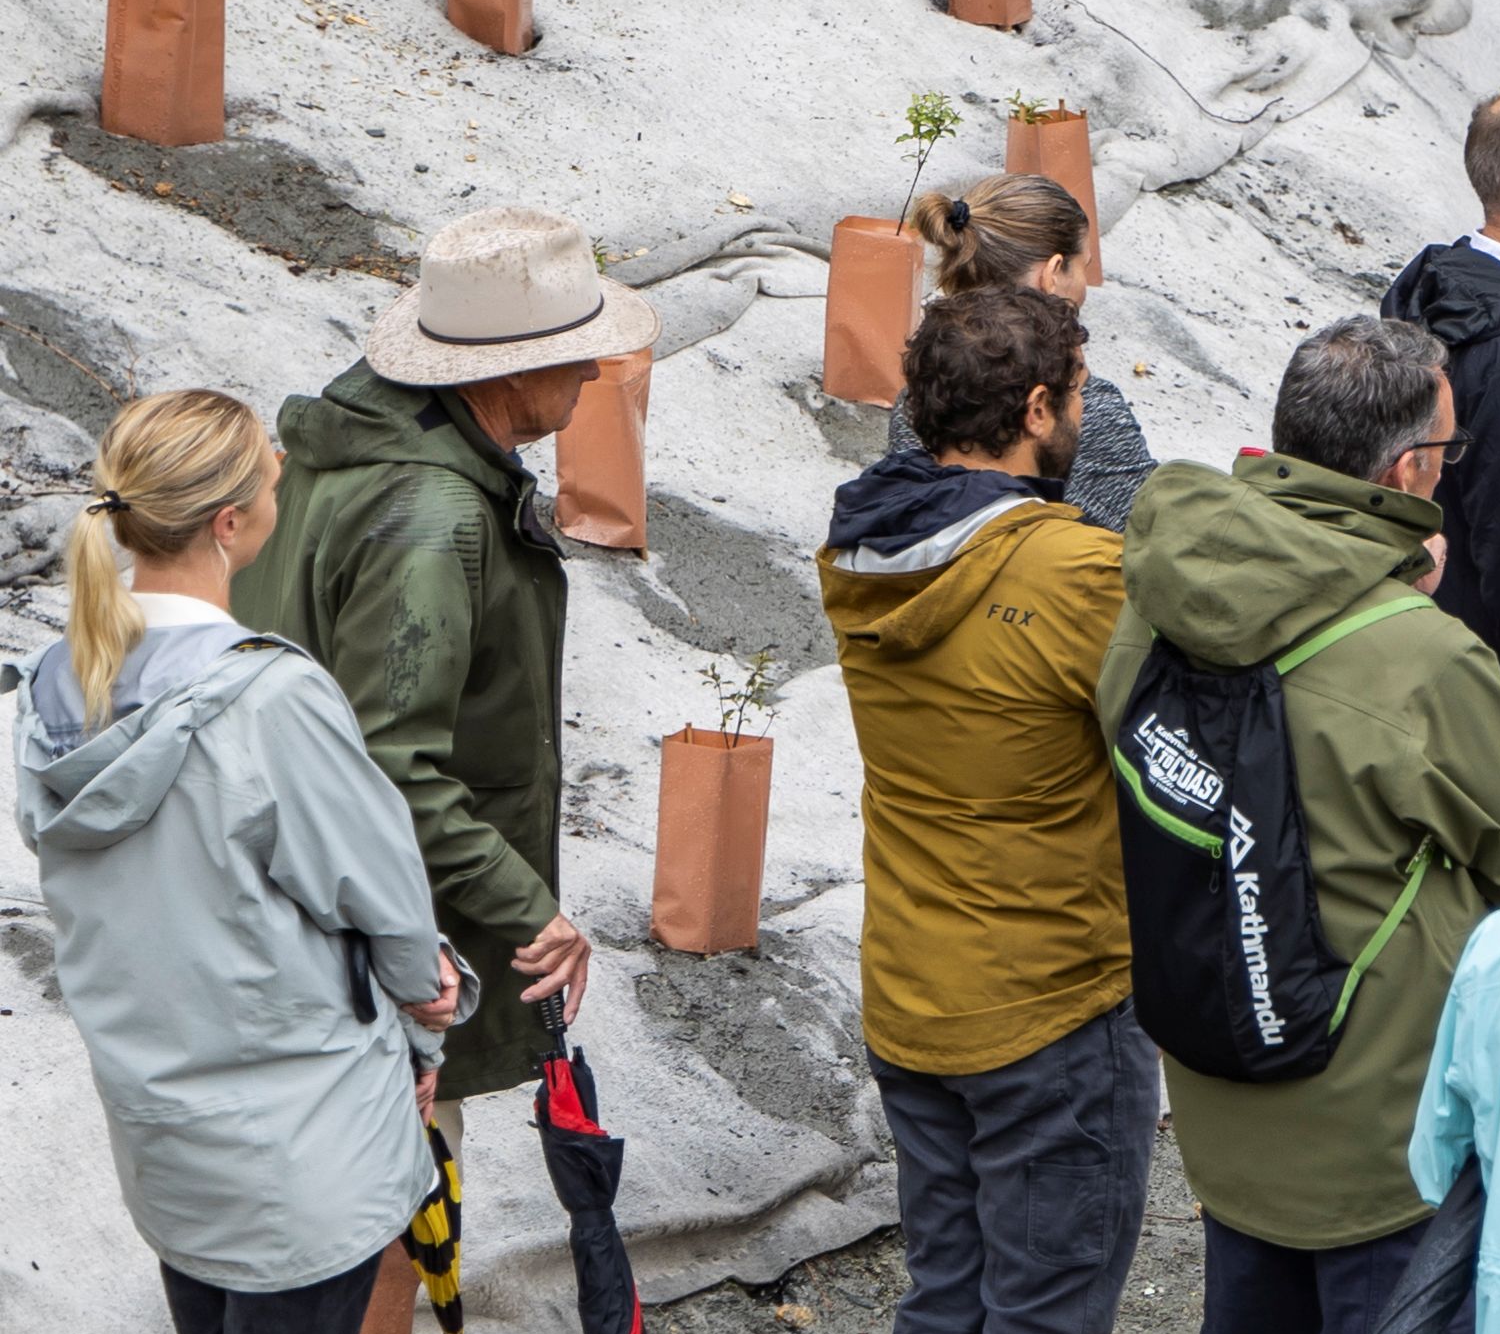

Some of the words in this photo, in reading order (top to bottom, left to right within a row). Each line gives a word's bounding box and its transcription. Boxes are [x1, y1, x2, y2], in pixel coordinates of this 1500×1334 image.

[986, 603, 1036, 627] FOX
[1166, 755, 1224, 805] COAST
[1234, 872, 1286, 1046] Kathmandu
